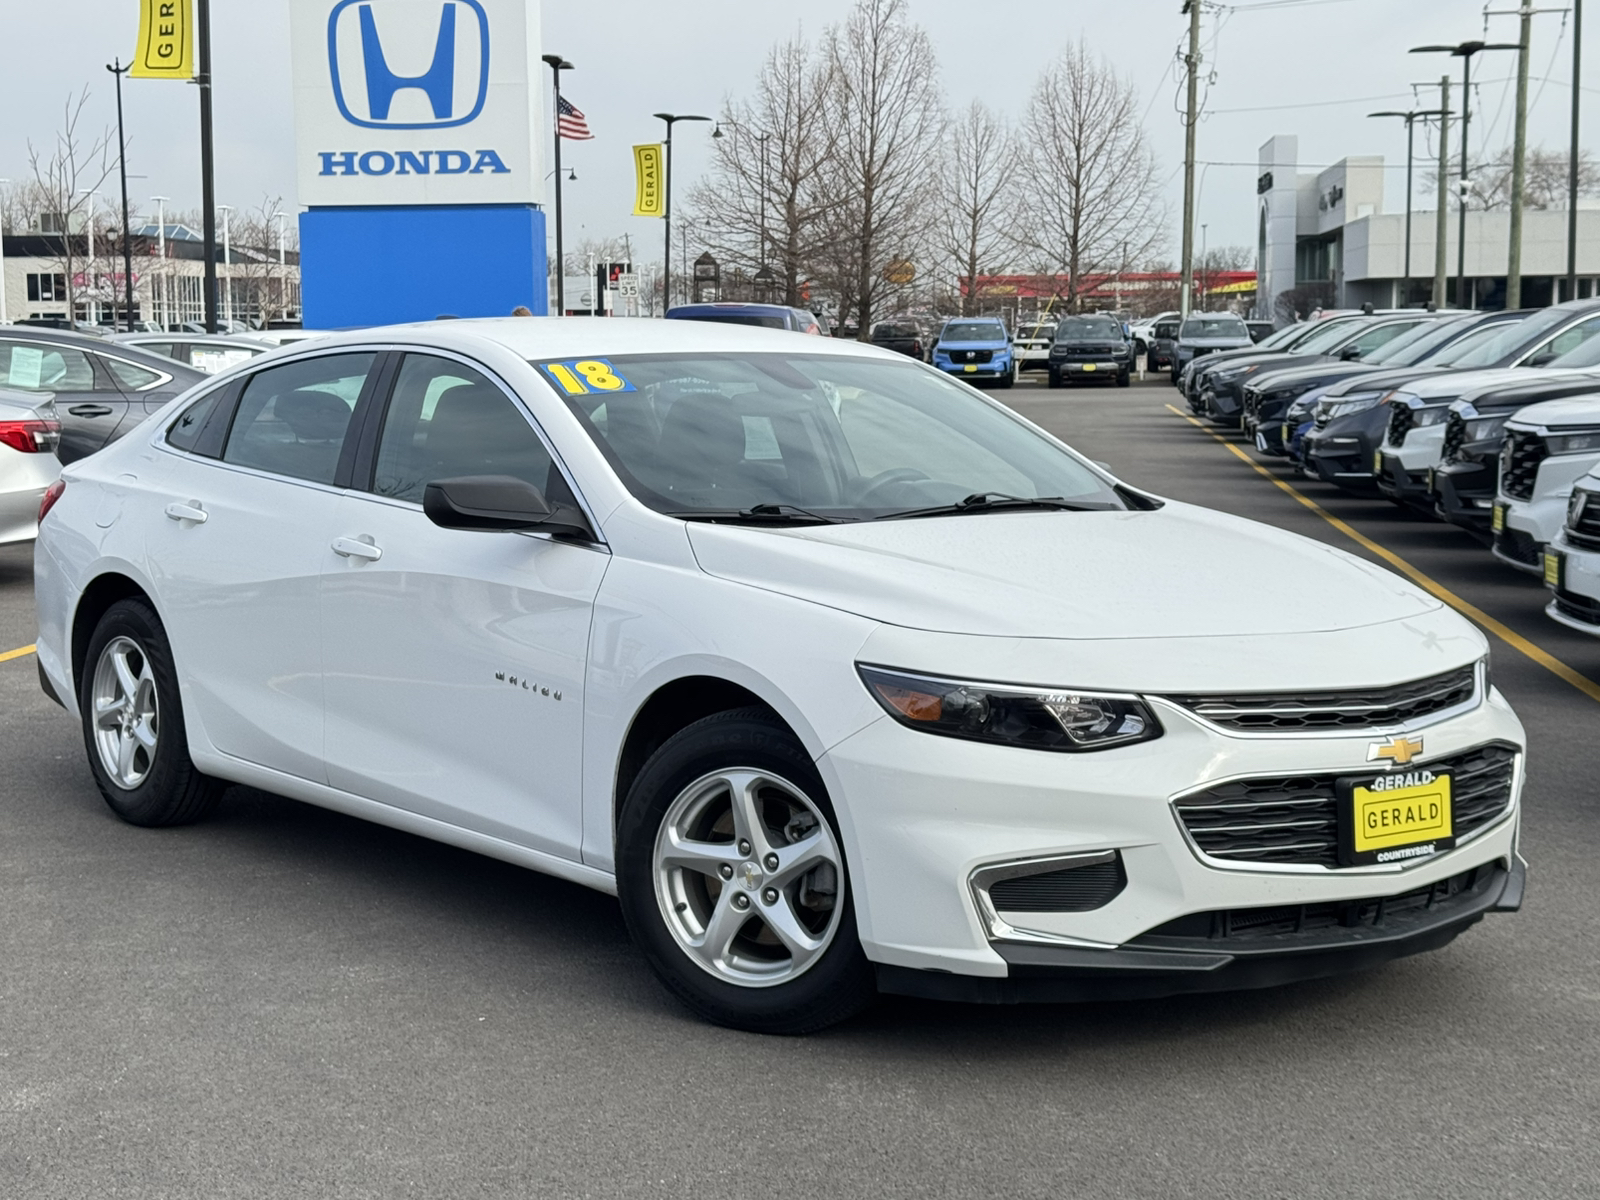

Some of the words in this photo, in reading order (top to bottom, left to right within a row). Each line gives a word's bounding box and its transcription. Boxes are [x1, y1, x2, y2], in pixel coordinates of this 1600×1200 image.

[318, 149, 512, 176] HONDA
[644, 153, 655, 208] GERALD
[621, 286, 638, 296] 35
[547, 360, 627, 395] 18
[1374, 770, 1433, 792] GERALD
[1367, 802, 1439, 829] GERALD
[1376, 844, 1436, 862] COUNTRYSIDE
